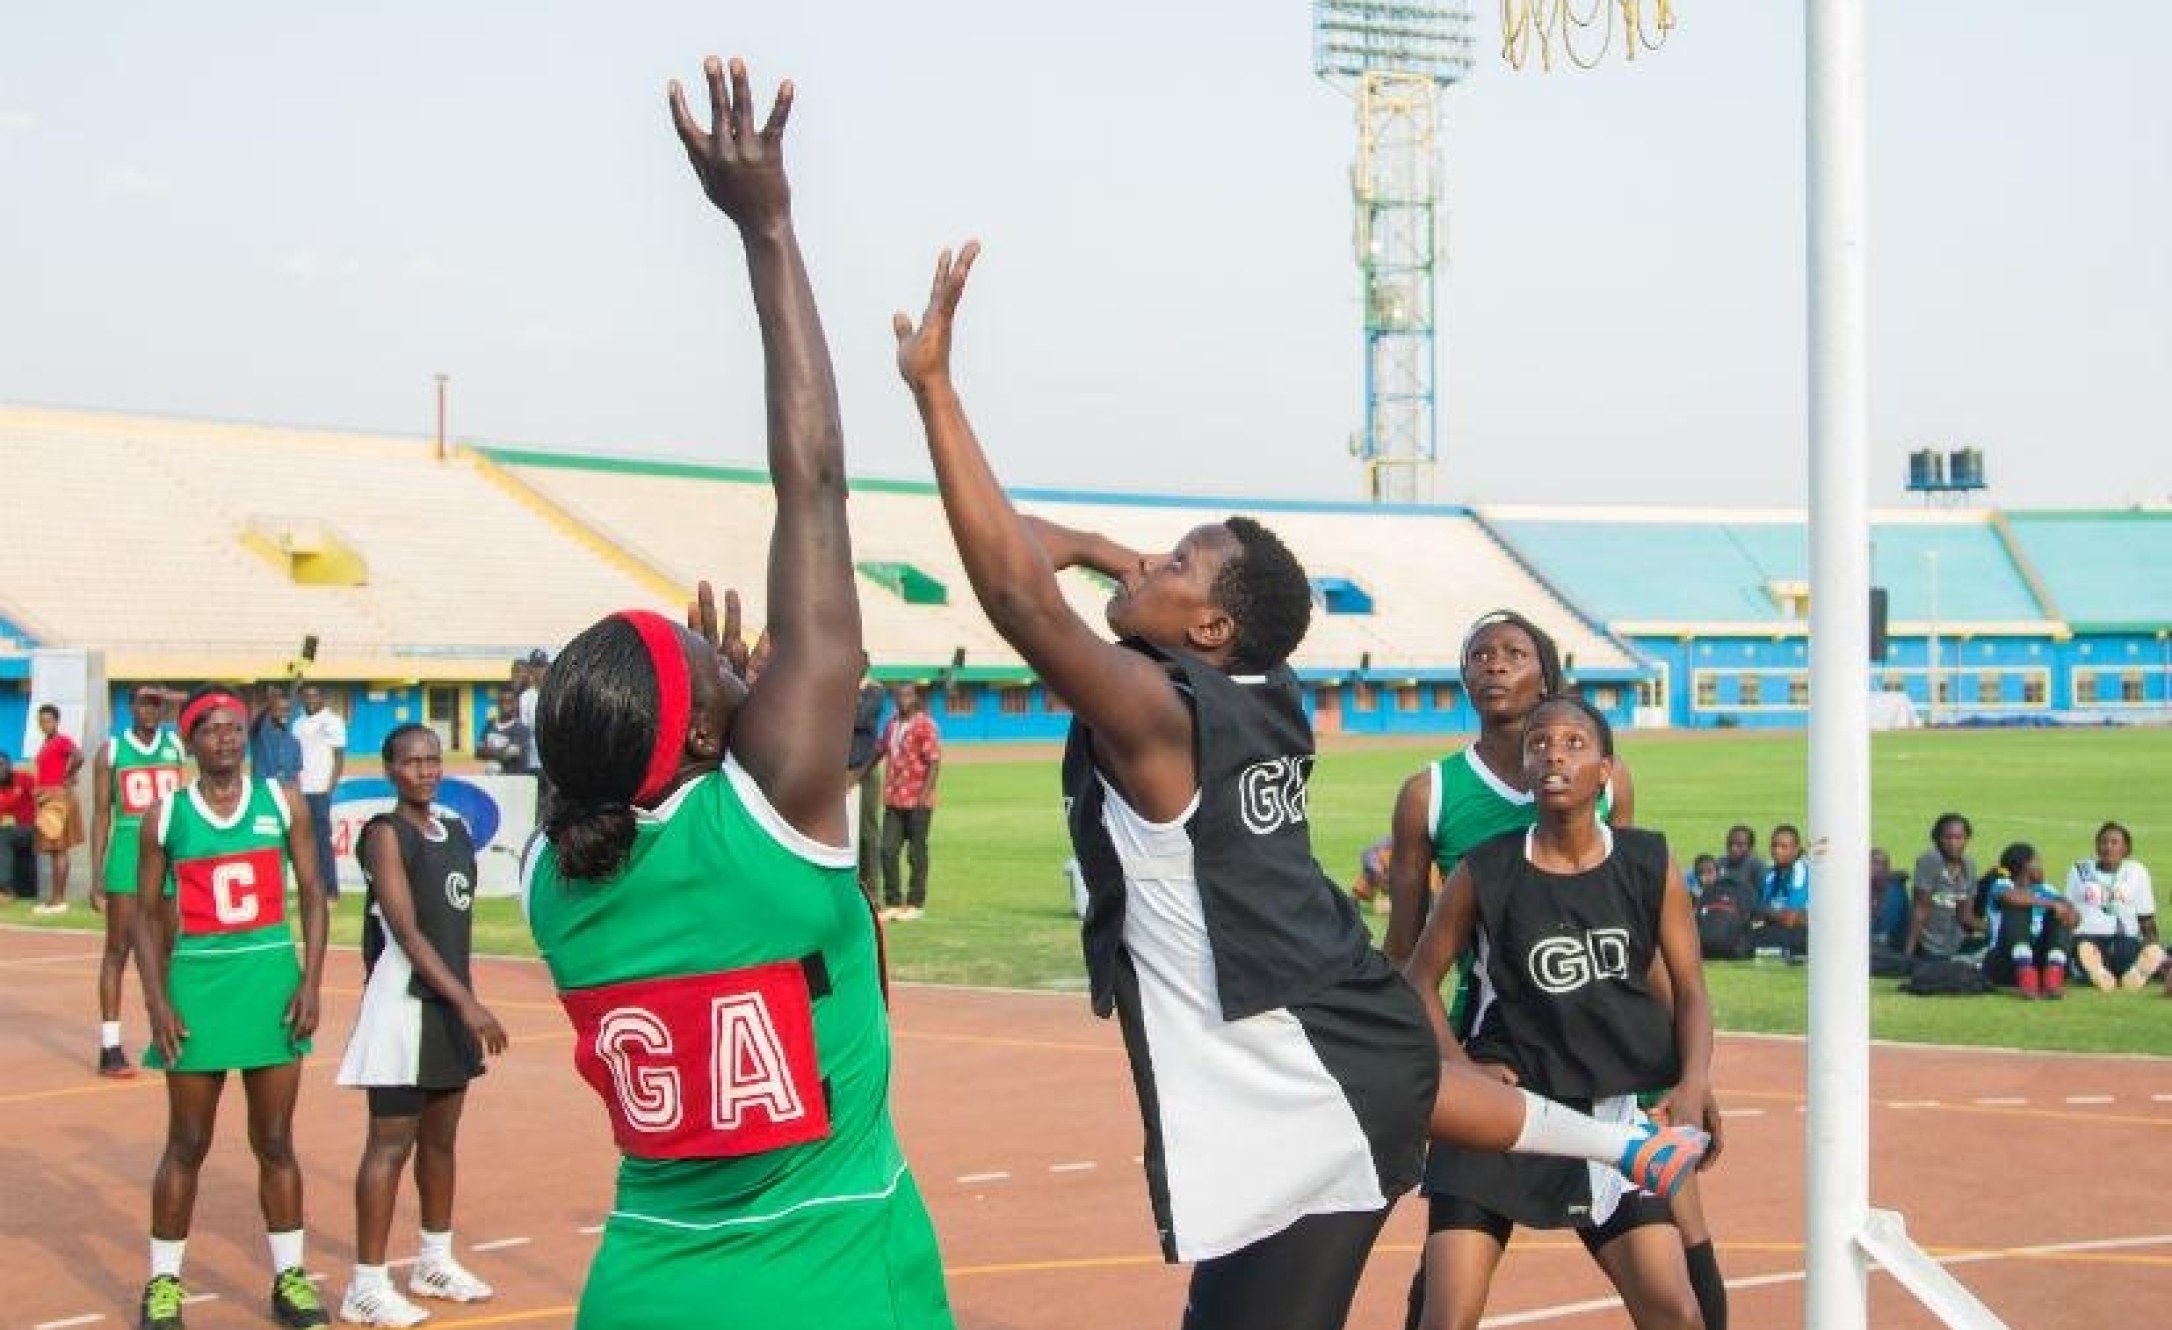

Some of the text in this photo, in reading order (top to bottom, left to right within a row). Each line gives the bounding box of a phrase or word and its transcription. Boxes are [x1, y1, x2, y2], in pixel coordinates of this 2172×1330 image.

[212, 862, 259, 924] C
[445, 871, 471, 911] C
[1529, 928, 1630, 993] GD
[595, 990, 805, 1132] GA
